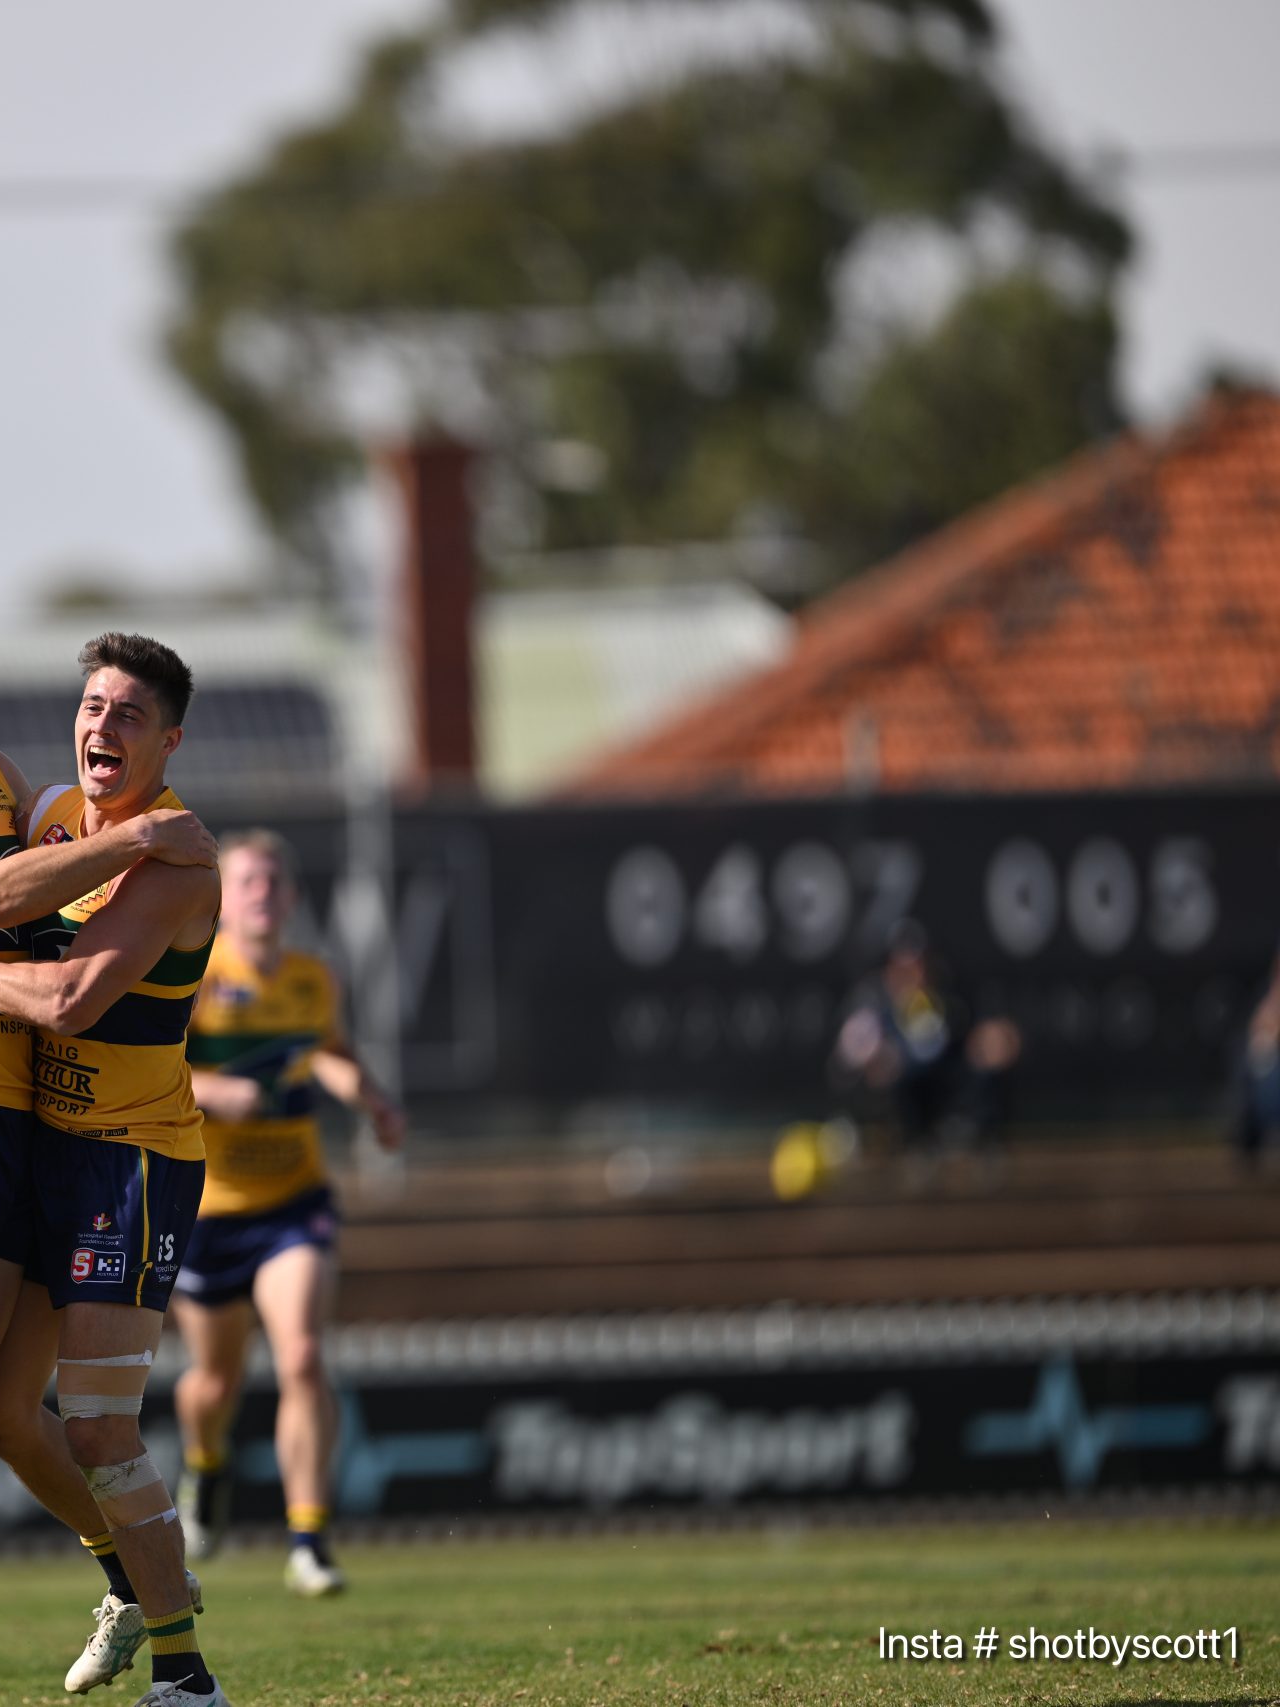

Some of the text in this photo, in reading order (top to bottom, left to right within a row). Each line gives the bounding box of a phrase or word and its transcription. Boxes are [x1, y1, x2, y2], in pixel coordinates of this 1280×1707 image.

[985, 838, 1218, 955] 005
[33, 1059, 94, 1096] THUR
[37, 1036, 79, 1061] RAIG
[492, 1394, 912, 1511] TopSport
